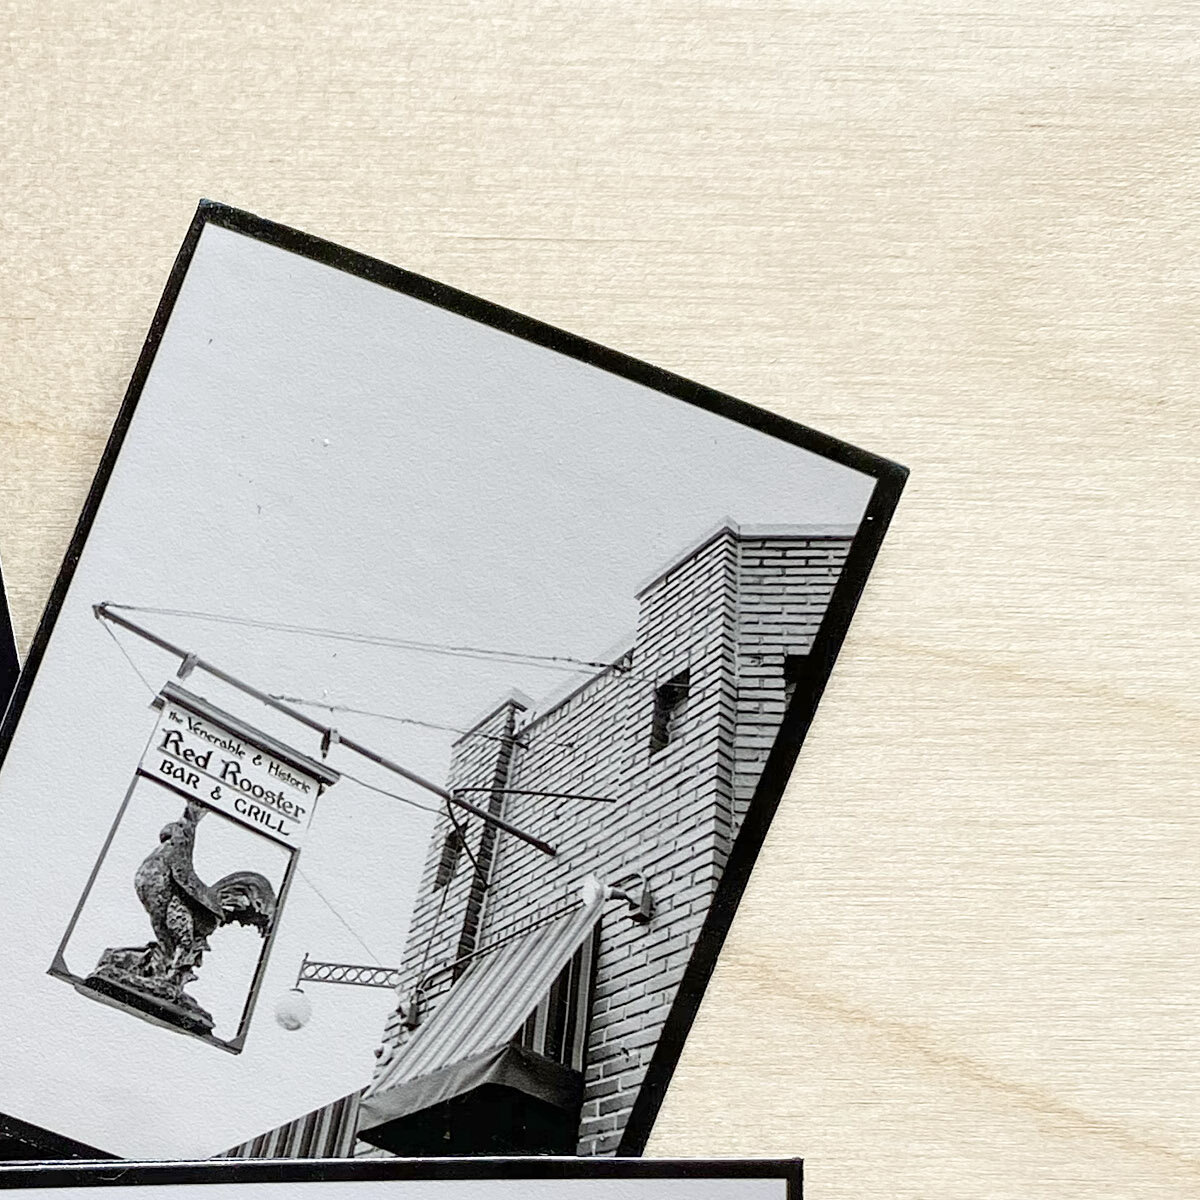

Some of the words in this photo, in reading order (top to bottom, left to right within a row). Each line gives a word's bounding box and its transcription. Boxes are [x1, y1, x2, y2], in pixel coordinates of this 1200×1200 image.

[161, 728, 213, 770] Red
[219, 759, 306, 818] Rooster
[186, 716, 246, 759] Venerable
[252, 754, 262, 766] &
[268, 761, 311, 794] Historic
[159, 759, 200, 790] BAR
[210, 785, 222, 801] &
[234, 798, 290, 836] GRILL
